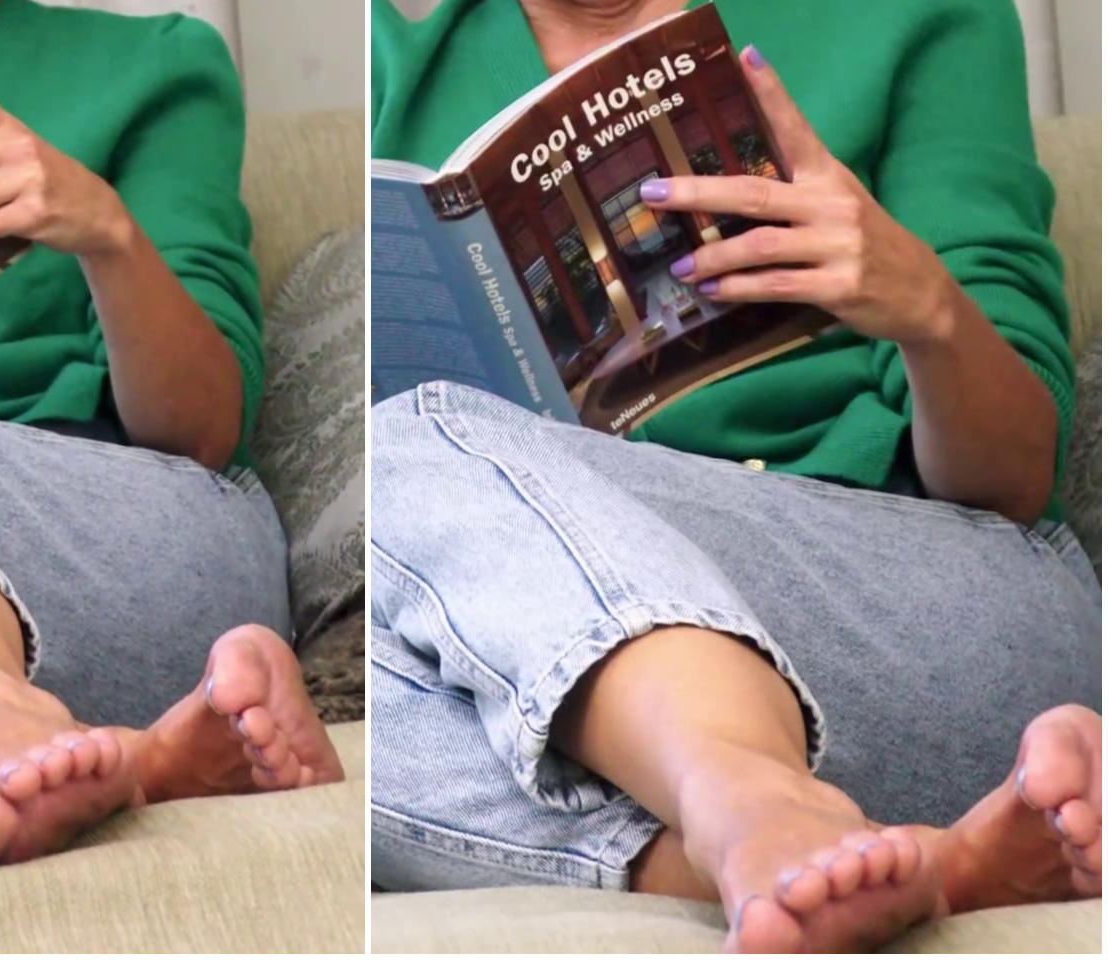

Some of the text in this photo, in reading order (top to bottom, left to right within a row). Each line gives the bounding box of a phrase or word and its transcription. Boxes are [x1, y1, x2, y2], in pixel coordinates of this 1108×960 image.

[510, 53, 696, 183] Cool Hotels
[539, 92, 685, 191] Spa & Wellness
[467, 242, 542, 404] Cool Hotels Spa & Wellness
[610, 393, 656, 430] teNeues
